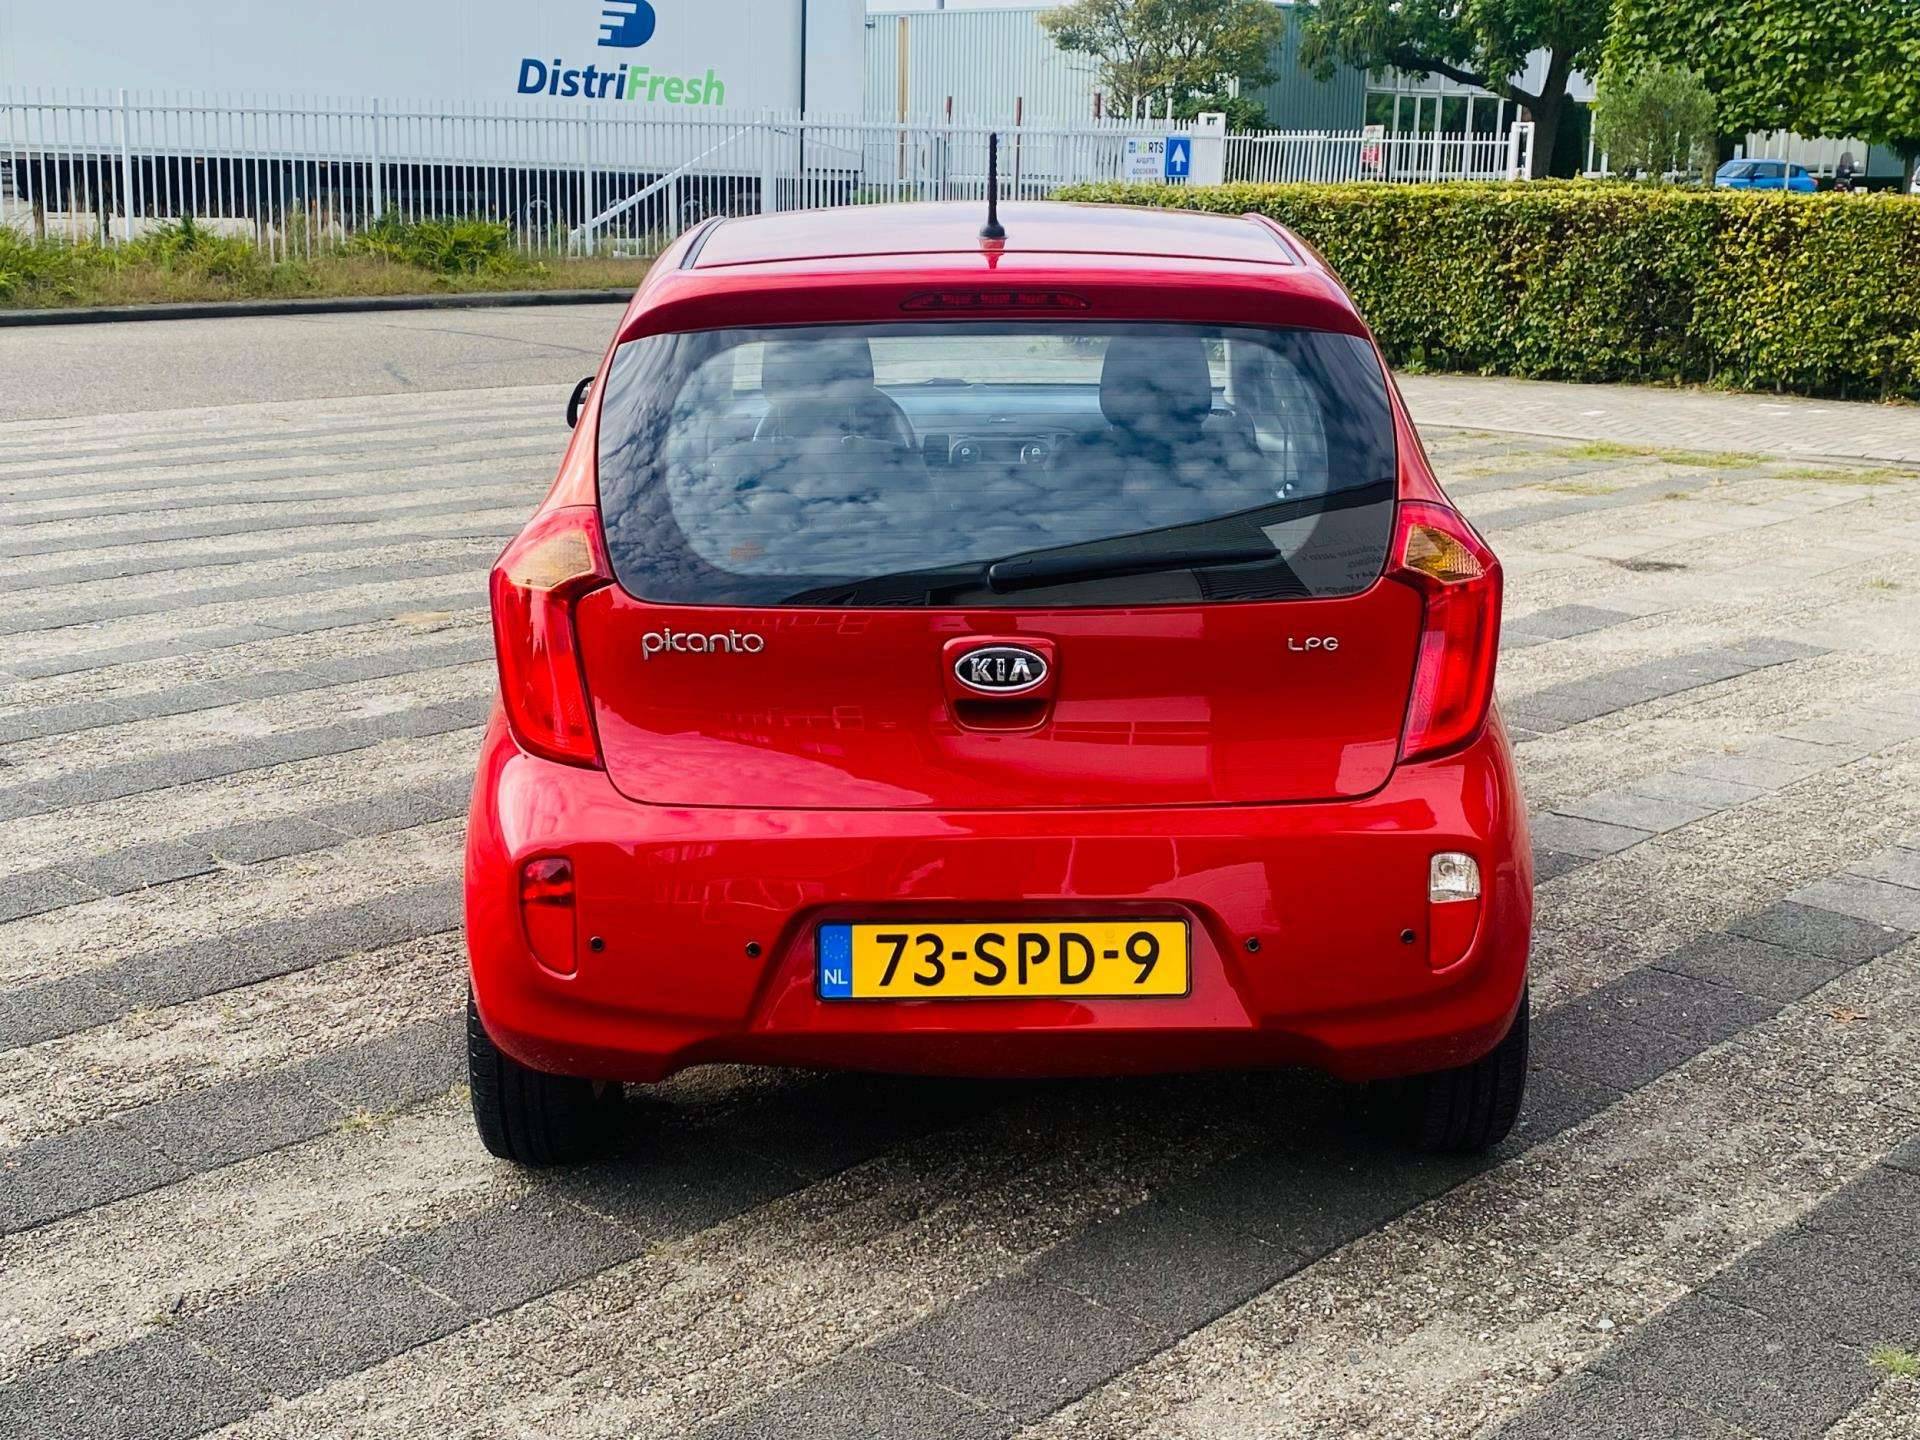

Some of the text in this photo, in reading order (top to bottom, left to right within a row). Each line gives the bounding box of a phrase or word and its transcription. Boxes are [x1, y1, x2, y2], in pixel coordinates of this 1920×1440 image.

[517, 58, 725, 106] DistriFresh
[642, 627, 765, 661] picanto
[1287, 636, 1339, 651] LPG
[970, 657, 1033, 683] KIA
[875, 931, 1161, 987] 73-SPD-9
[824, 969, 848, 985] NL
